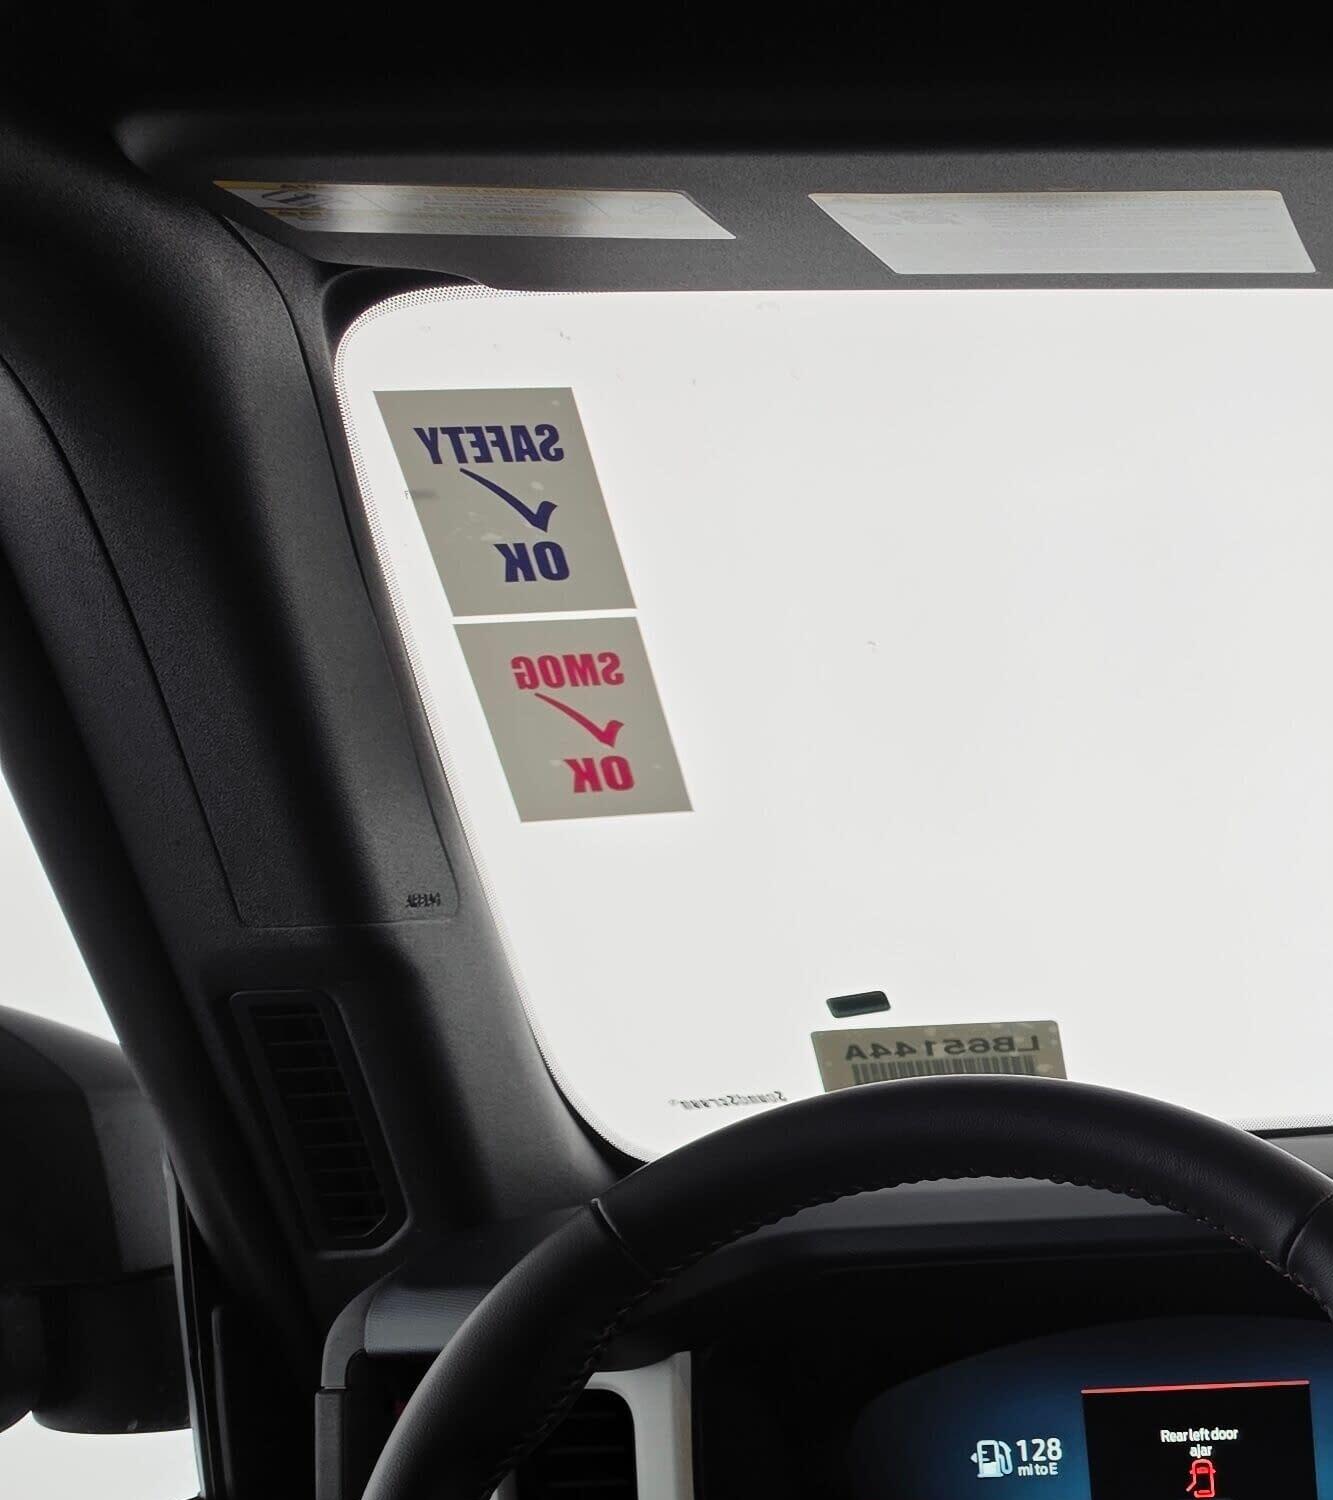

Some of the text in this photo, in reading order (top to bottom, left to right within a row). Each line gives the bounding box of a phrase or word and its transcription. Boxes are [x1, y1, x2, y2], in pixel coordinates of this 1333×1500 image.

[1160, 1427, 1238, 1442] Rear left door
[1016, 1437, 1062, 1461] 128
[1189, 1443, 1213, 1458] ajar
[1017, 1462, 1058, 1476] mi to E
